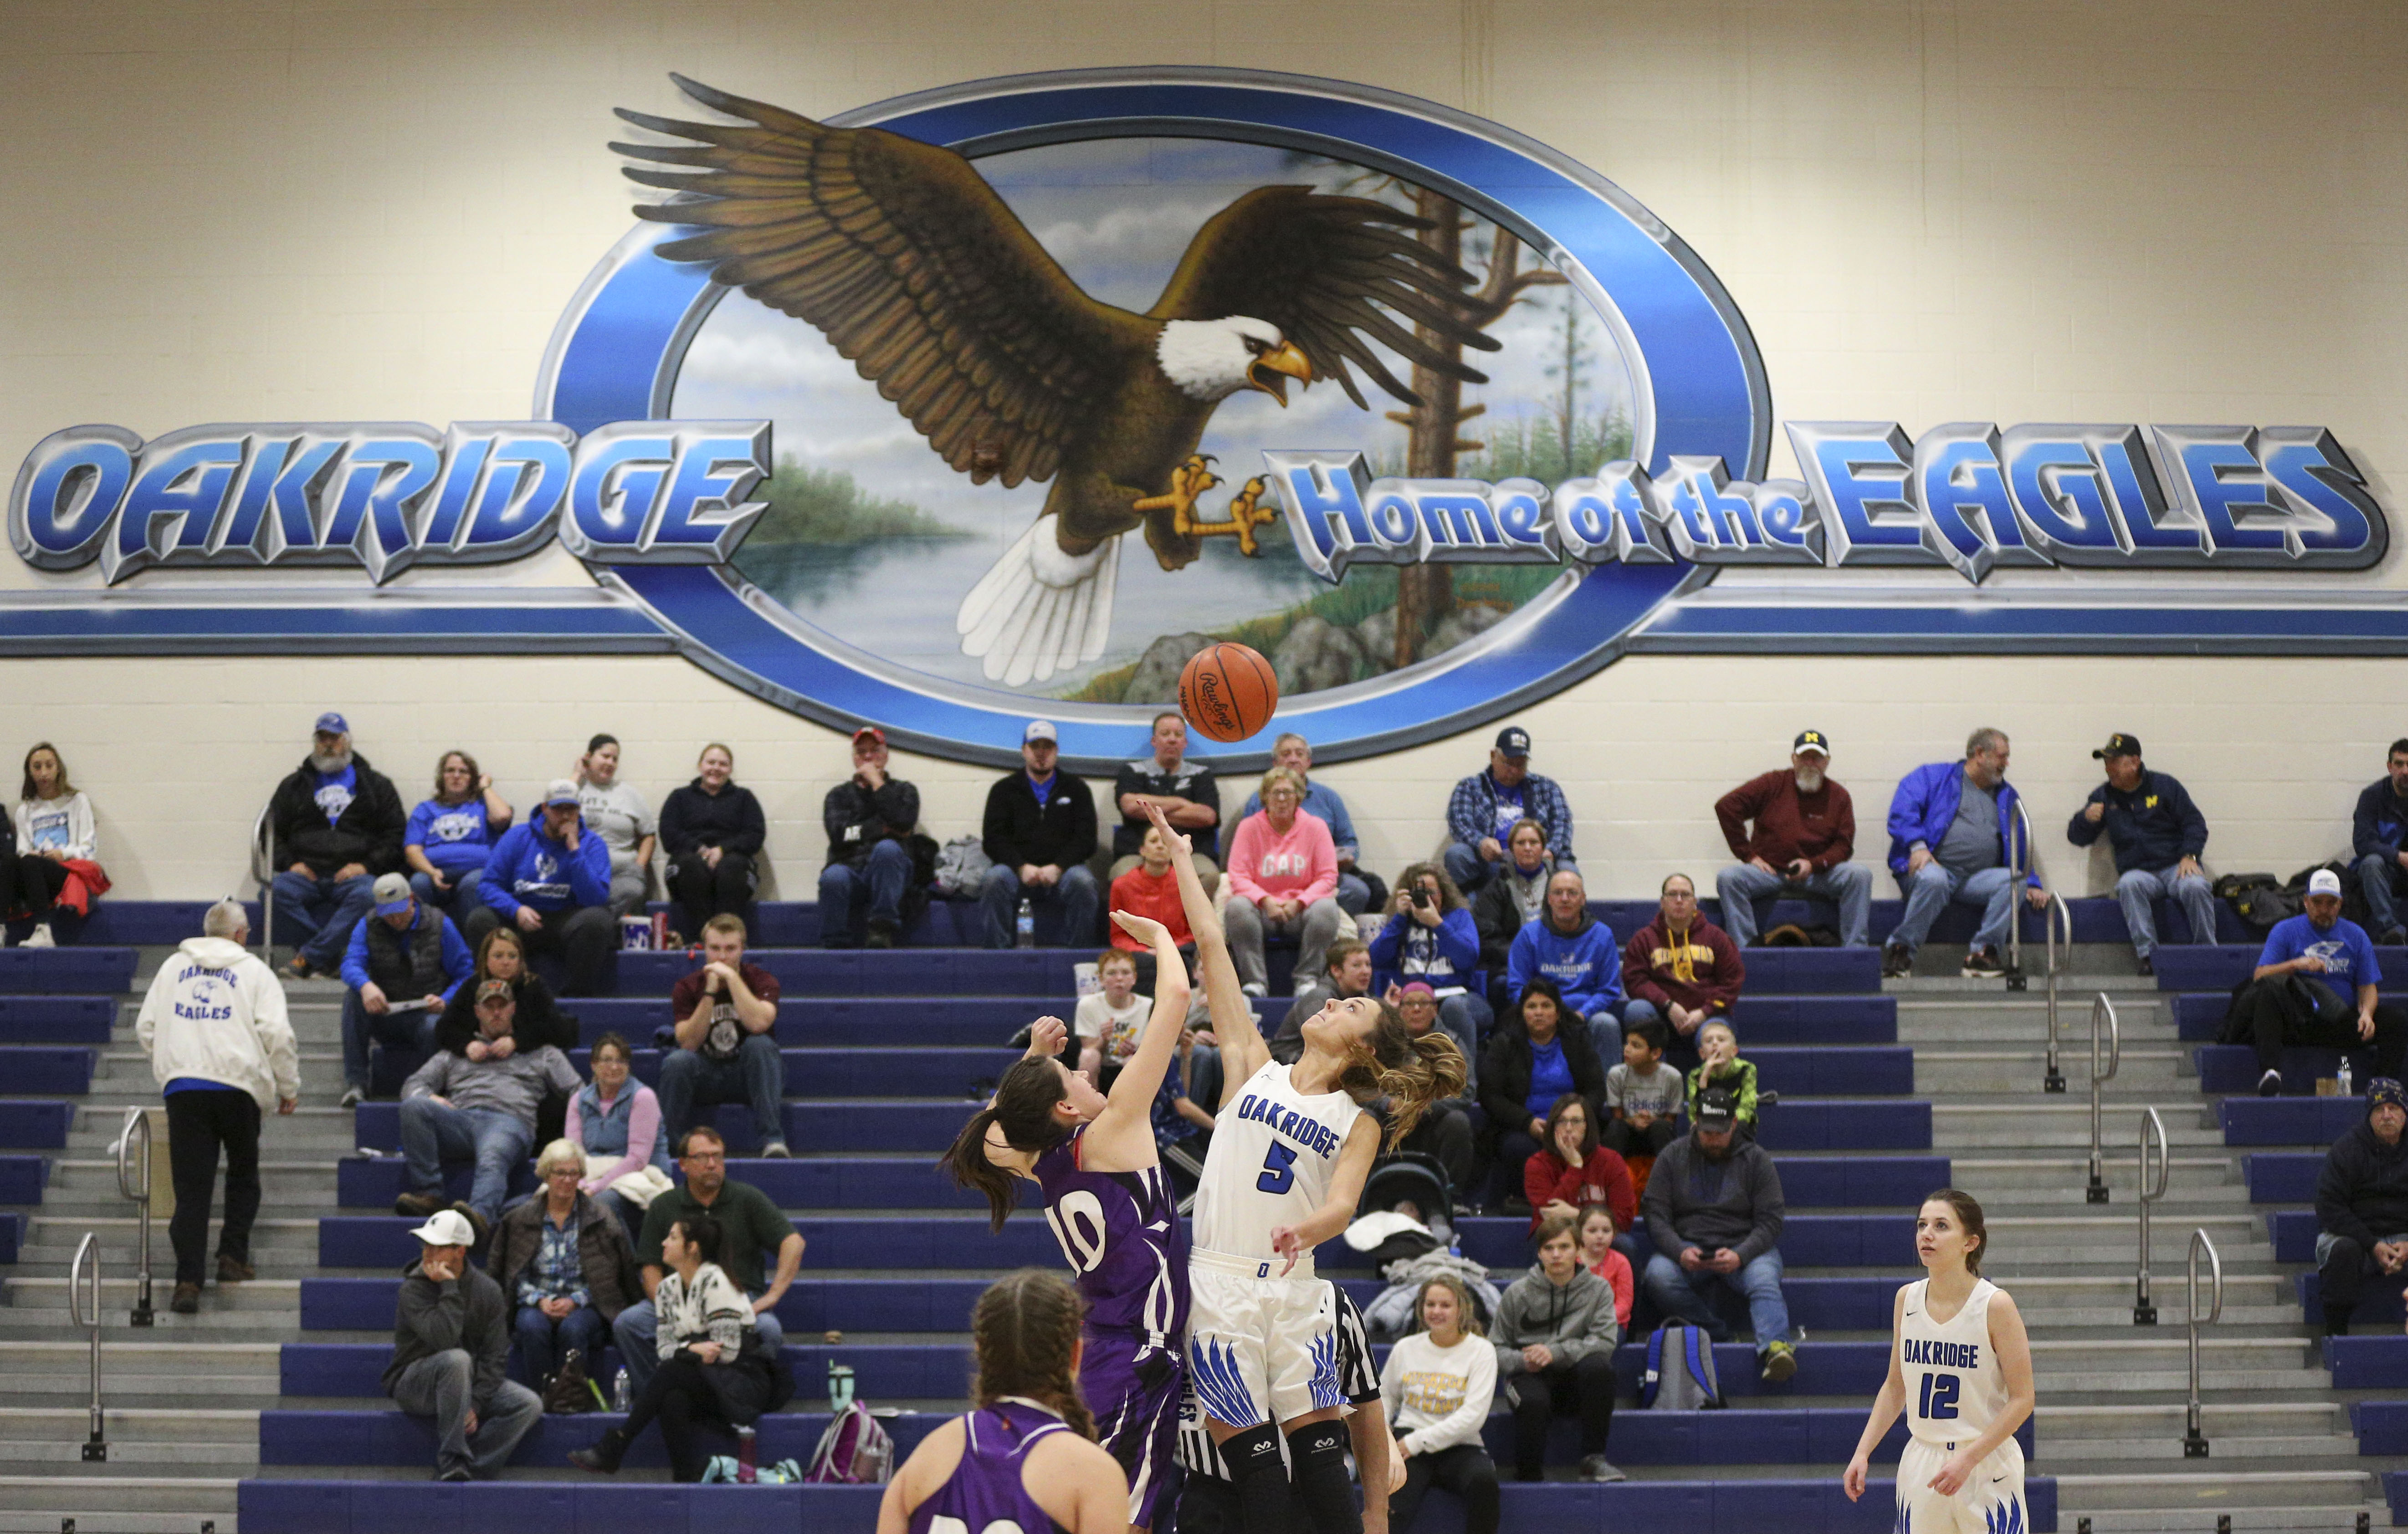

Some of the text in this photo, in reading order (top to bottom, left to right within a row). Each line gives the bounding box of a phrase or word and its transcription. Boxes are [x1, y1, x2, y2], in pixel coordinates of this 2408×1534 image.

[10, 421, 771, 586] OAKRIDGE
[1263, 422, 2387, 584] Home of the EAGLES
[1200, 673, 1234, 729] Rawlings
[1805, 732, 1818, 742] M
[2146, 795, 2158, 808] M
[1261, 854, 1305, 877] GAP
[178, 964, 237, 988] OAKRIDGE
[170, 1002, 231, 1019] EAGLES
[1239, 1094, 1340, 1160] OAKRIDGE
[1256, 1140, 1297, 1194] 5
[1044, 1190, 1106, 1278] 10
[1904, 1339, 1978, 1369] OAKRIDGE
[1405, 1392, 1465, 1414] AYHAWK
[1919, 1373, 1960, 1419] 12
